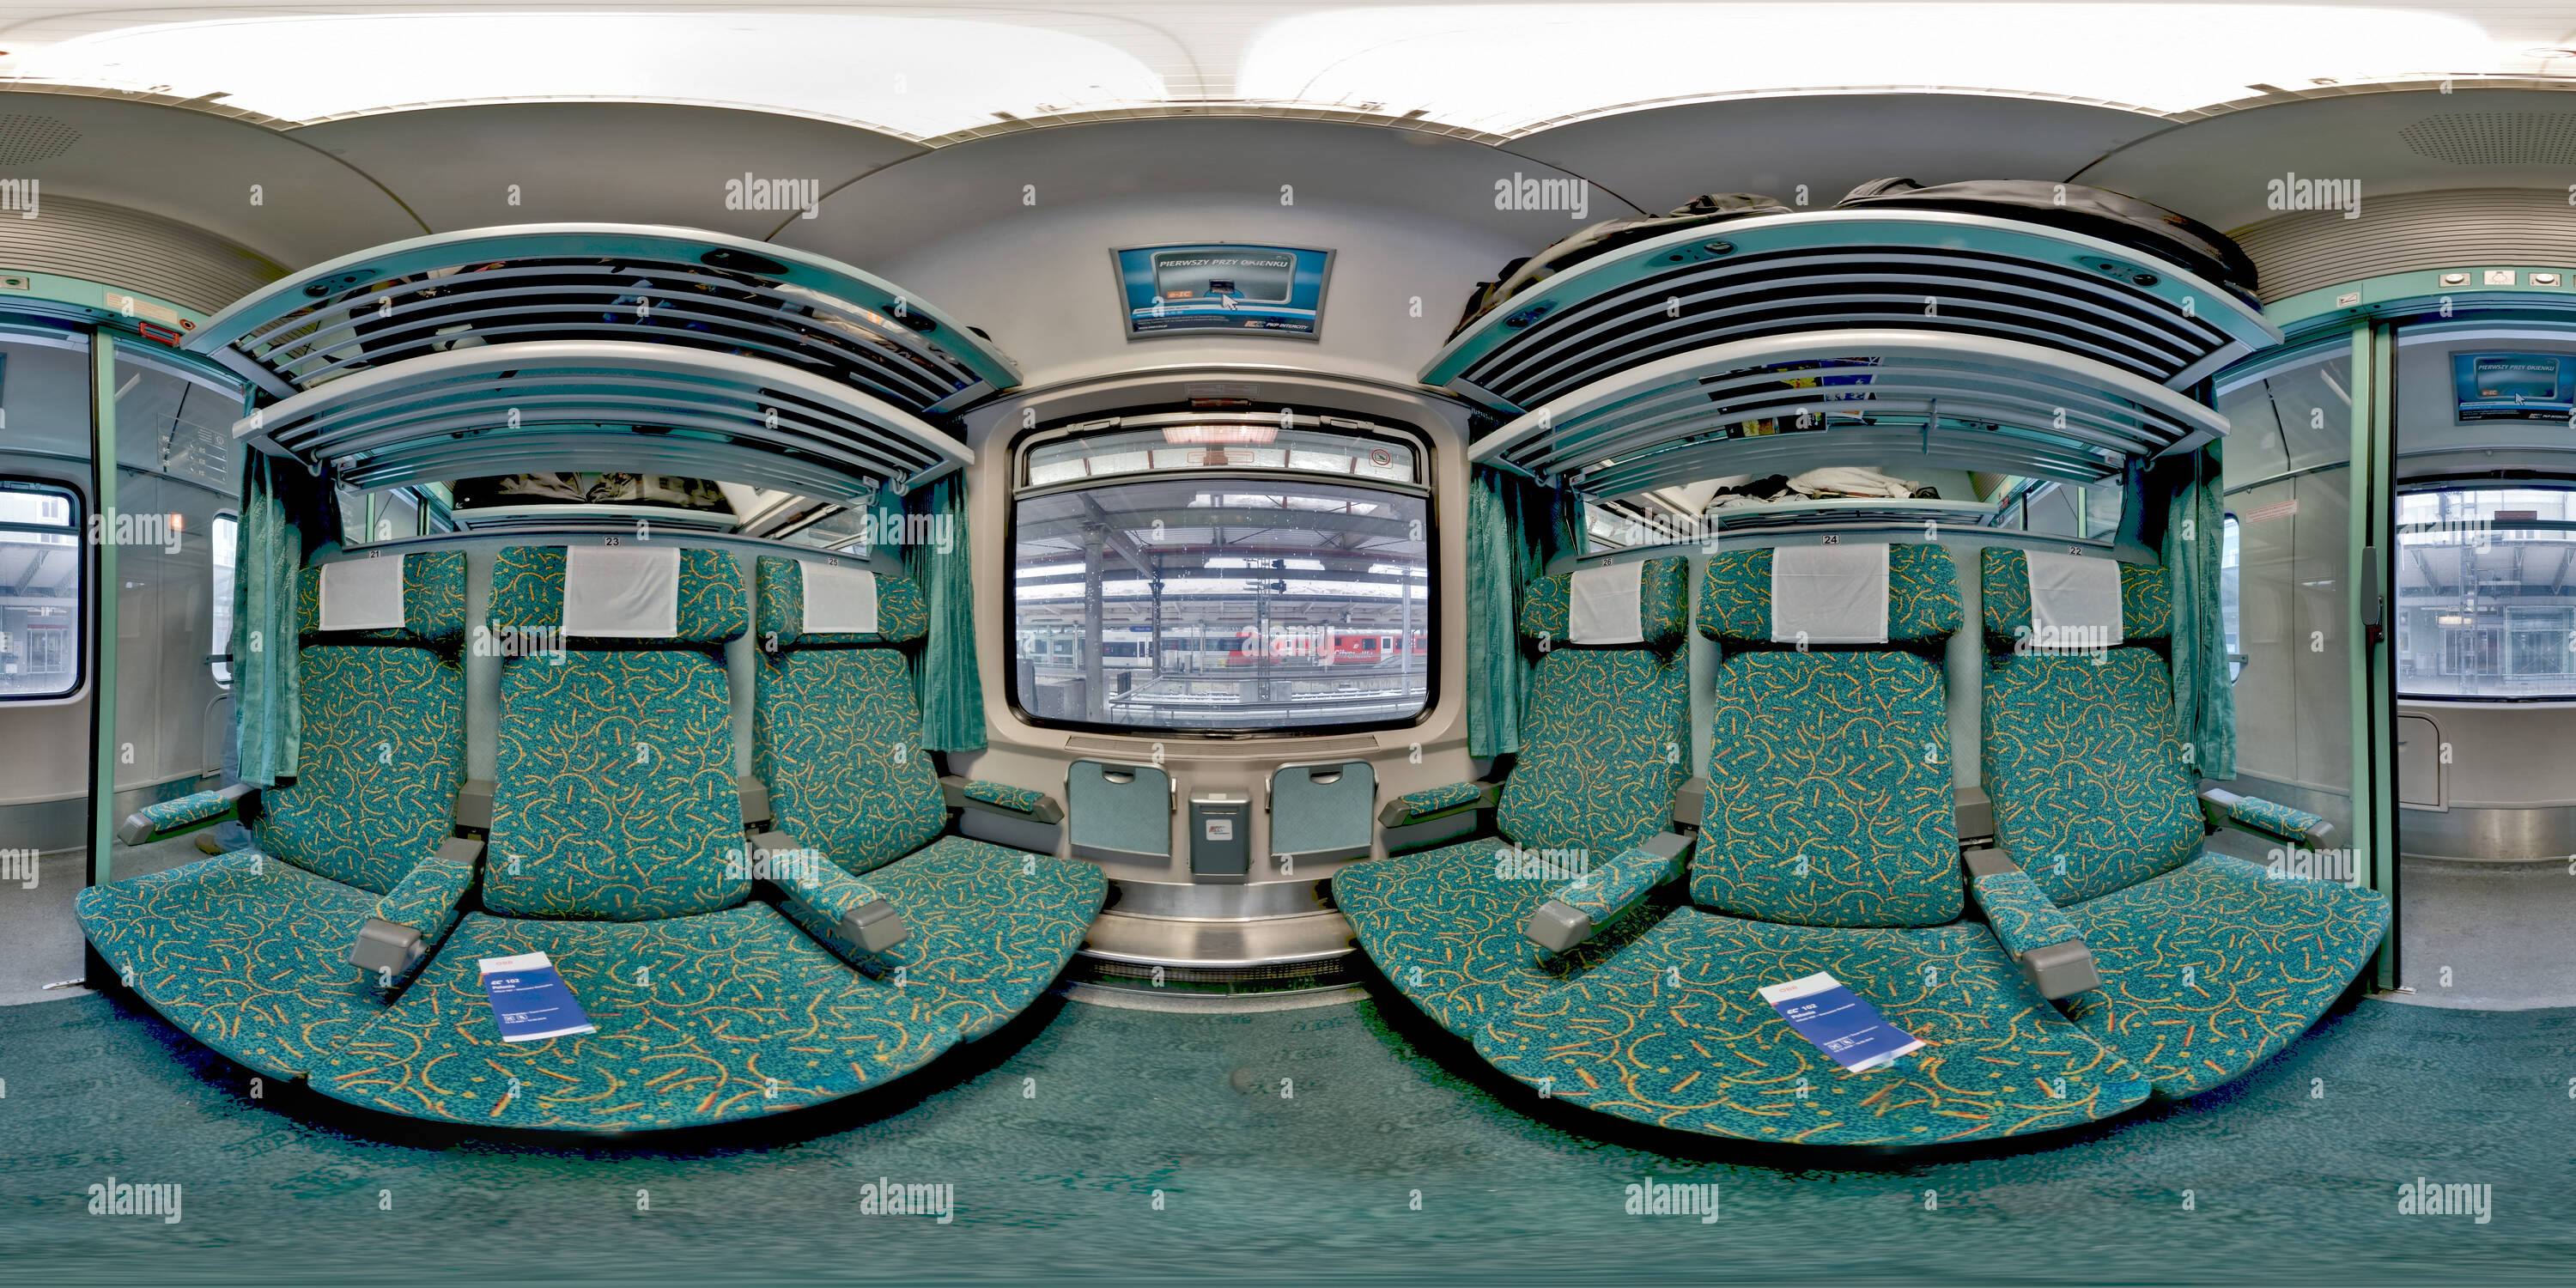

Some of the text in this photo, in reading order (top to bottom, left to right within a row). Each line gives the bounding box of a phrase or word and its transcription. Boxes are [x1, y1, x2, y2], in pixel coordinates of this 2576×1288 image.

[1159, 259, 1209, 268] PIERWSZY
[1241, 259, 1289, 268] OKIENKU
[606, 538, 619, 546] 23
[1824, 535, 1837, 544] 24
[2070, 546, 2081, 556] 22
